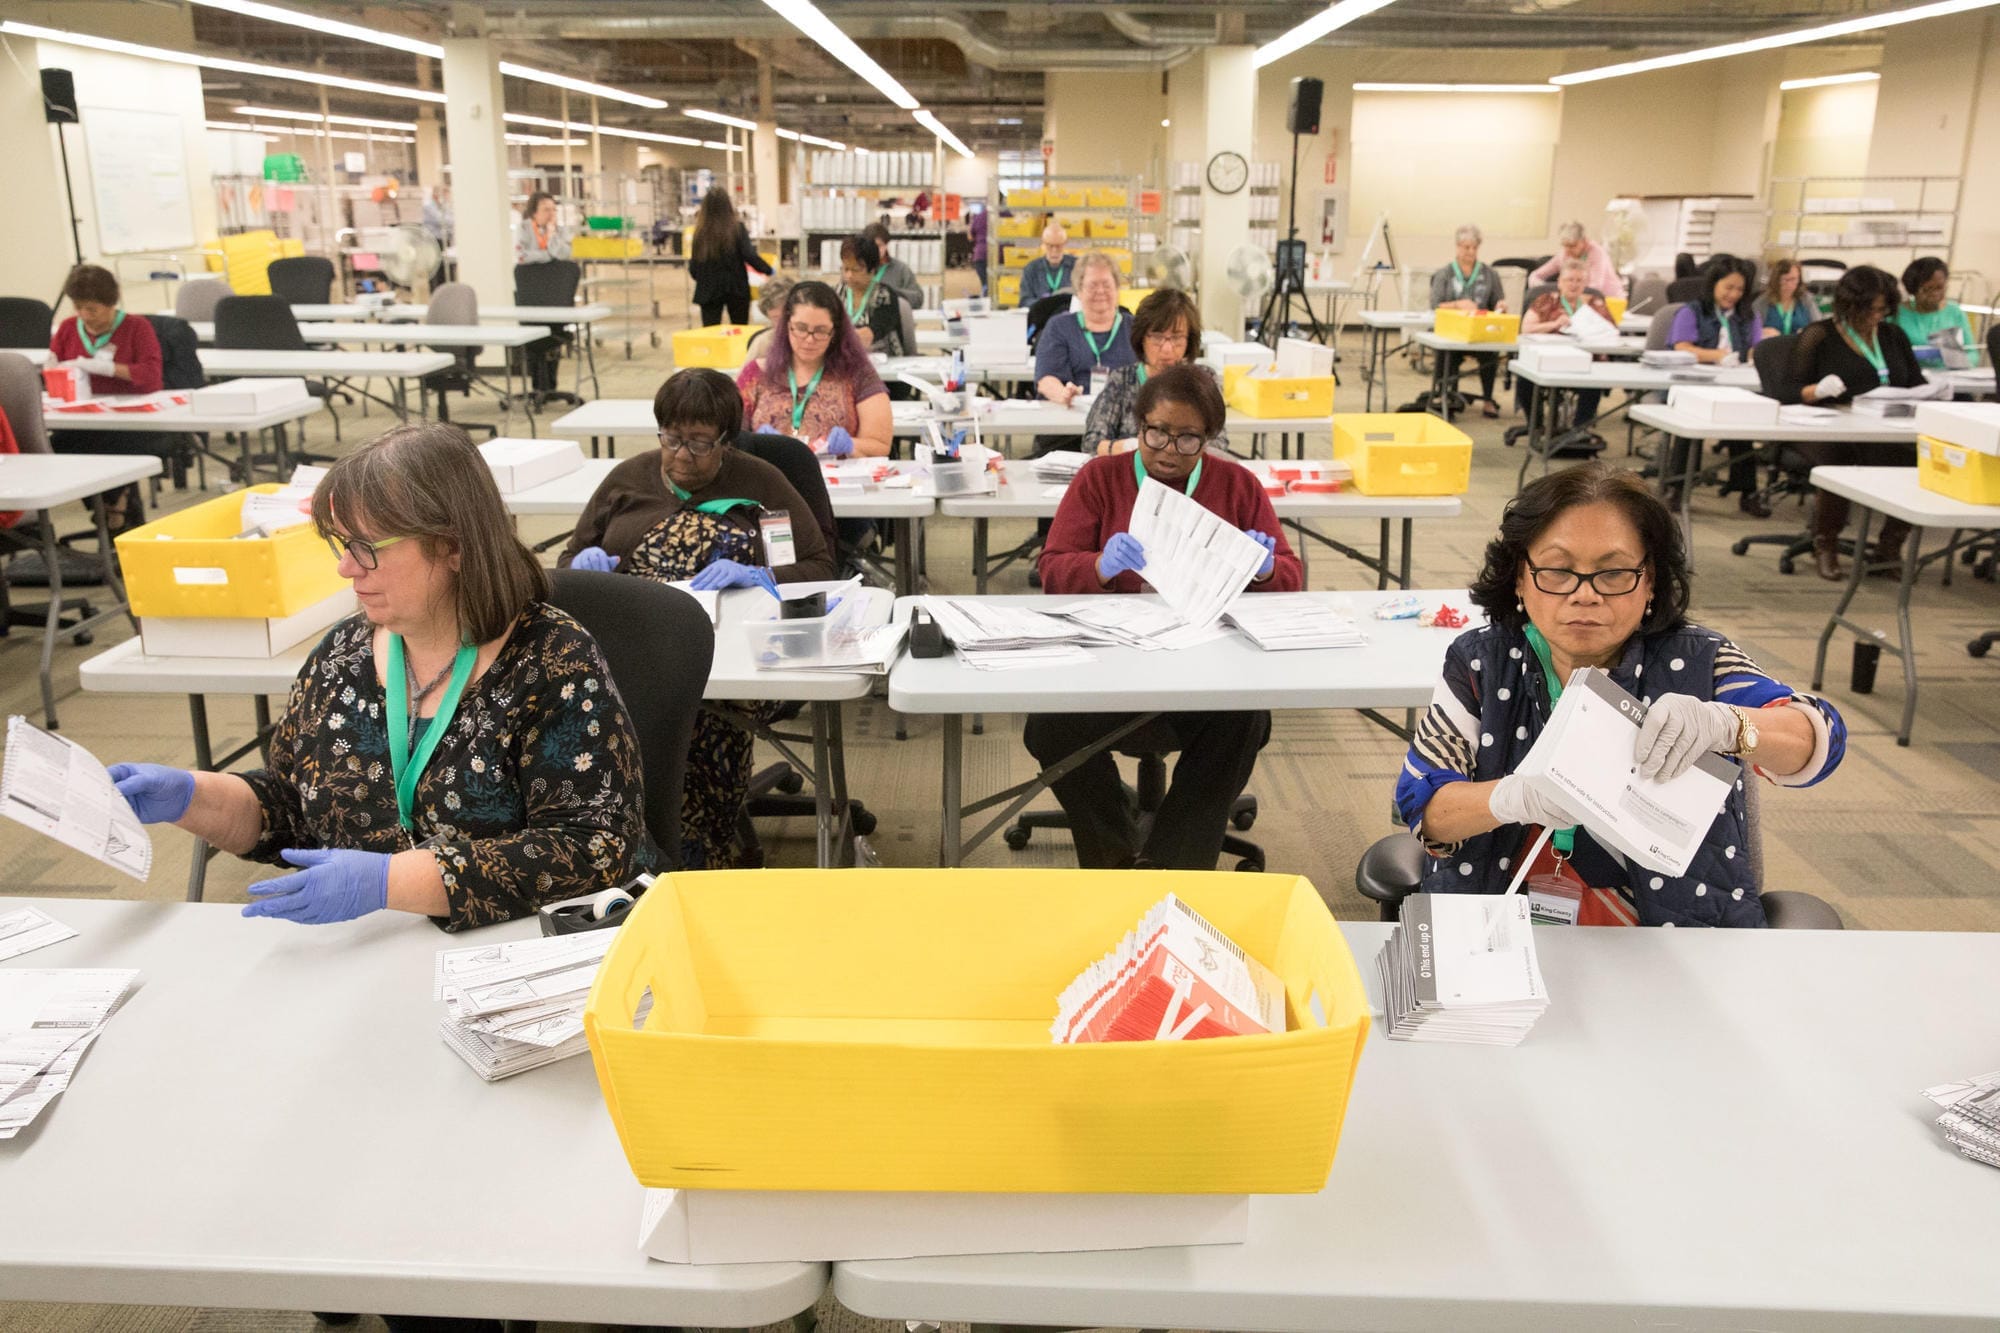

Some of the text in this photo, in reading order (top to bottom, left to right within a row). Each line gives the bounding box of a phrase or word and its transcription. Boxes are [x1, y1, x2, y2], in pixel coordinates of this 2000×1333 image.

[1541, 906, 1572, 918] King County
[1419, 932, 1432, 972] This end up
